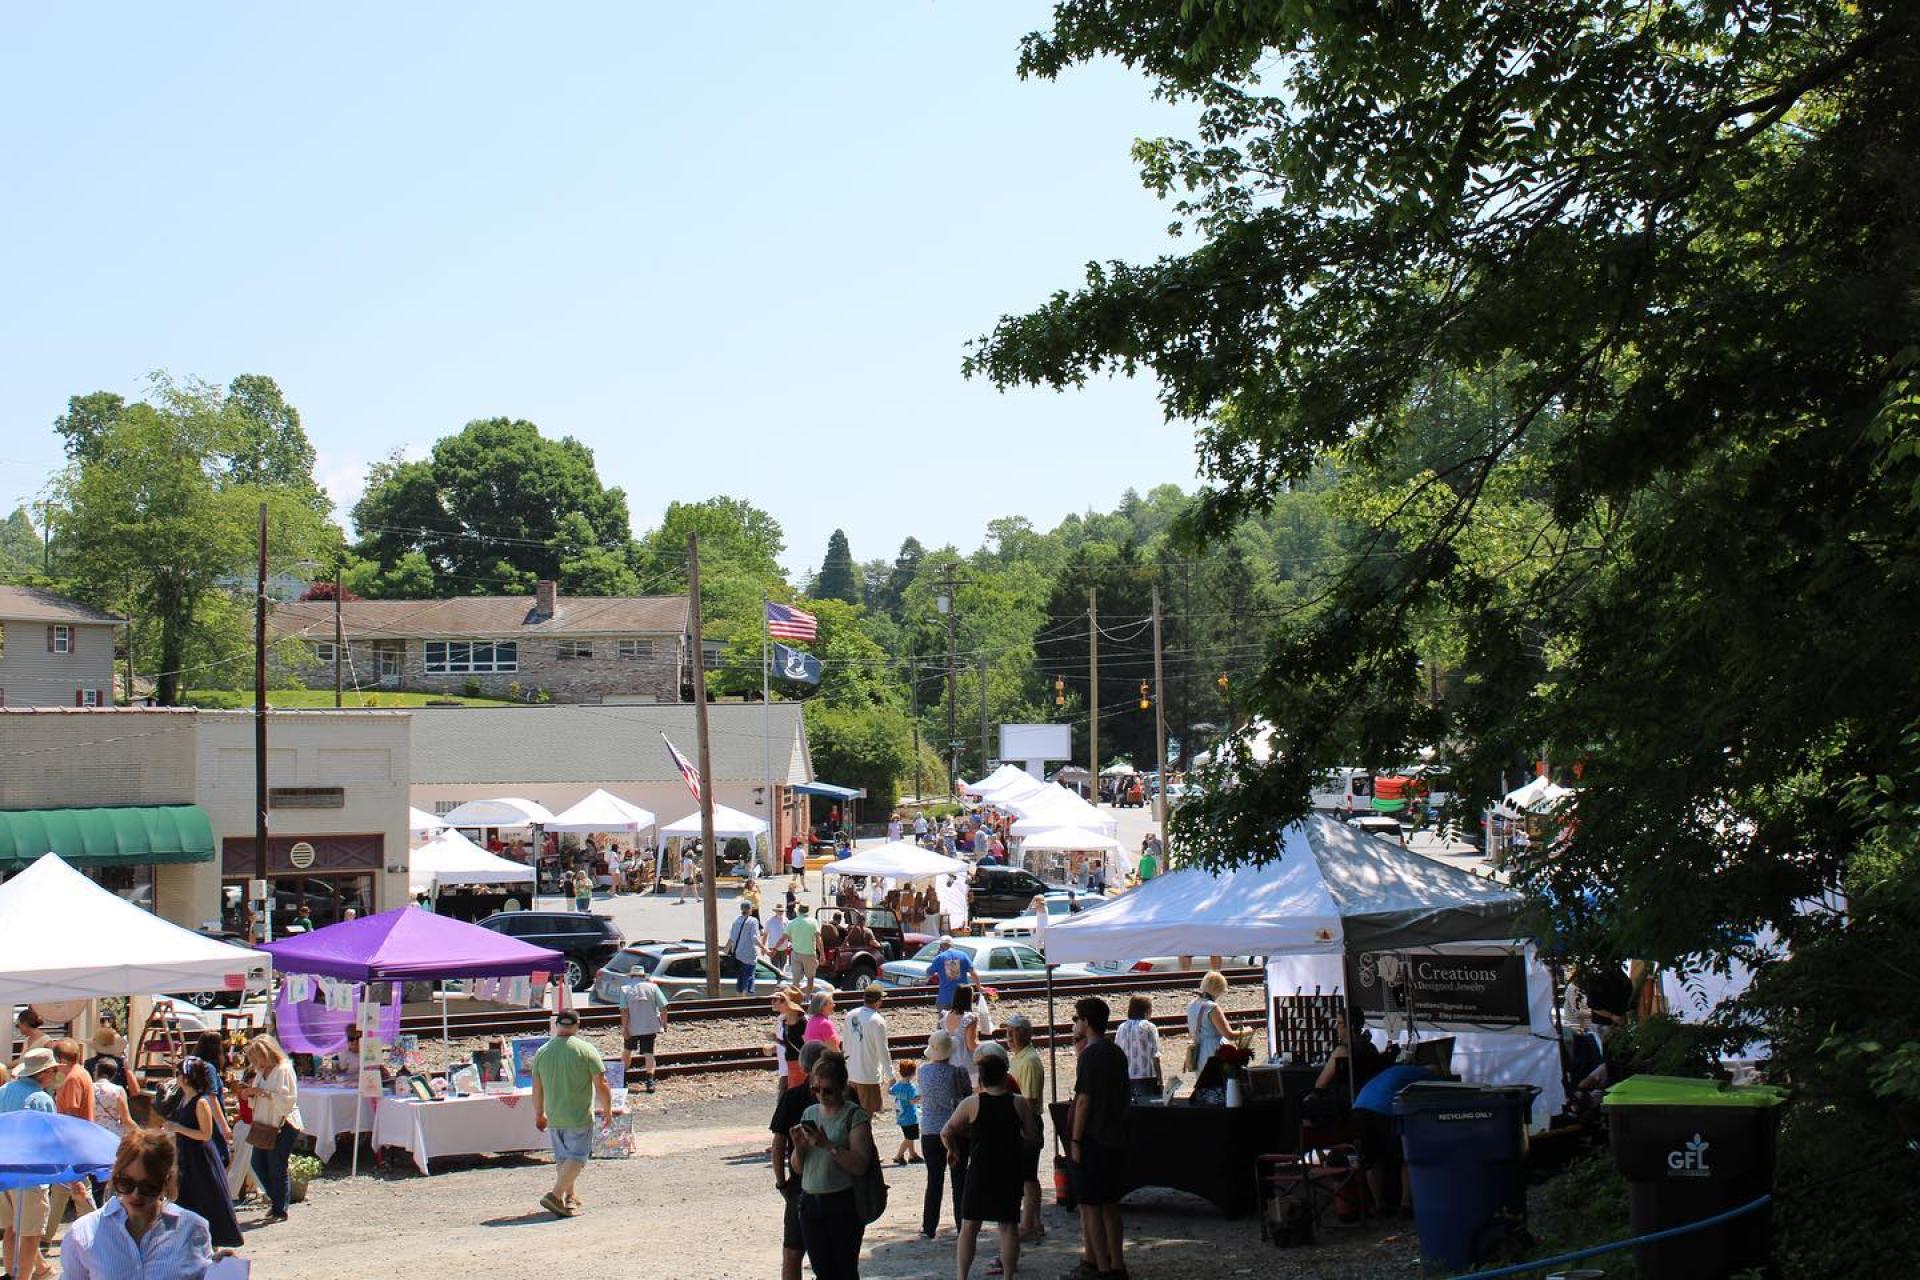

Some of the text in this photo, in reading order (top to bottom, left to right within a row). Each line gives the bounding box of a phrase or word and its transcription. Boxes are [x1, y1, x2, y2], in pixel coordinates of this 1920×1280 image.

[1418, 962, 1497, 981] Creations
[1456, 982, 1486, 993] Jewelry
[1438, 1111, 1493, 1121] RECYCLING ONLY
[1667, 1149, 1710, 1169] GFL
